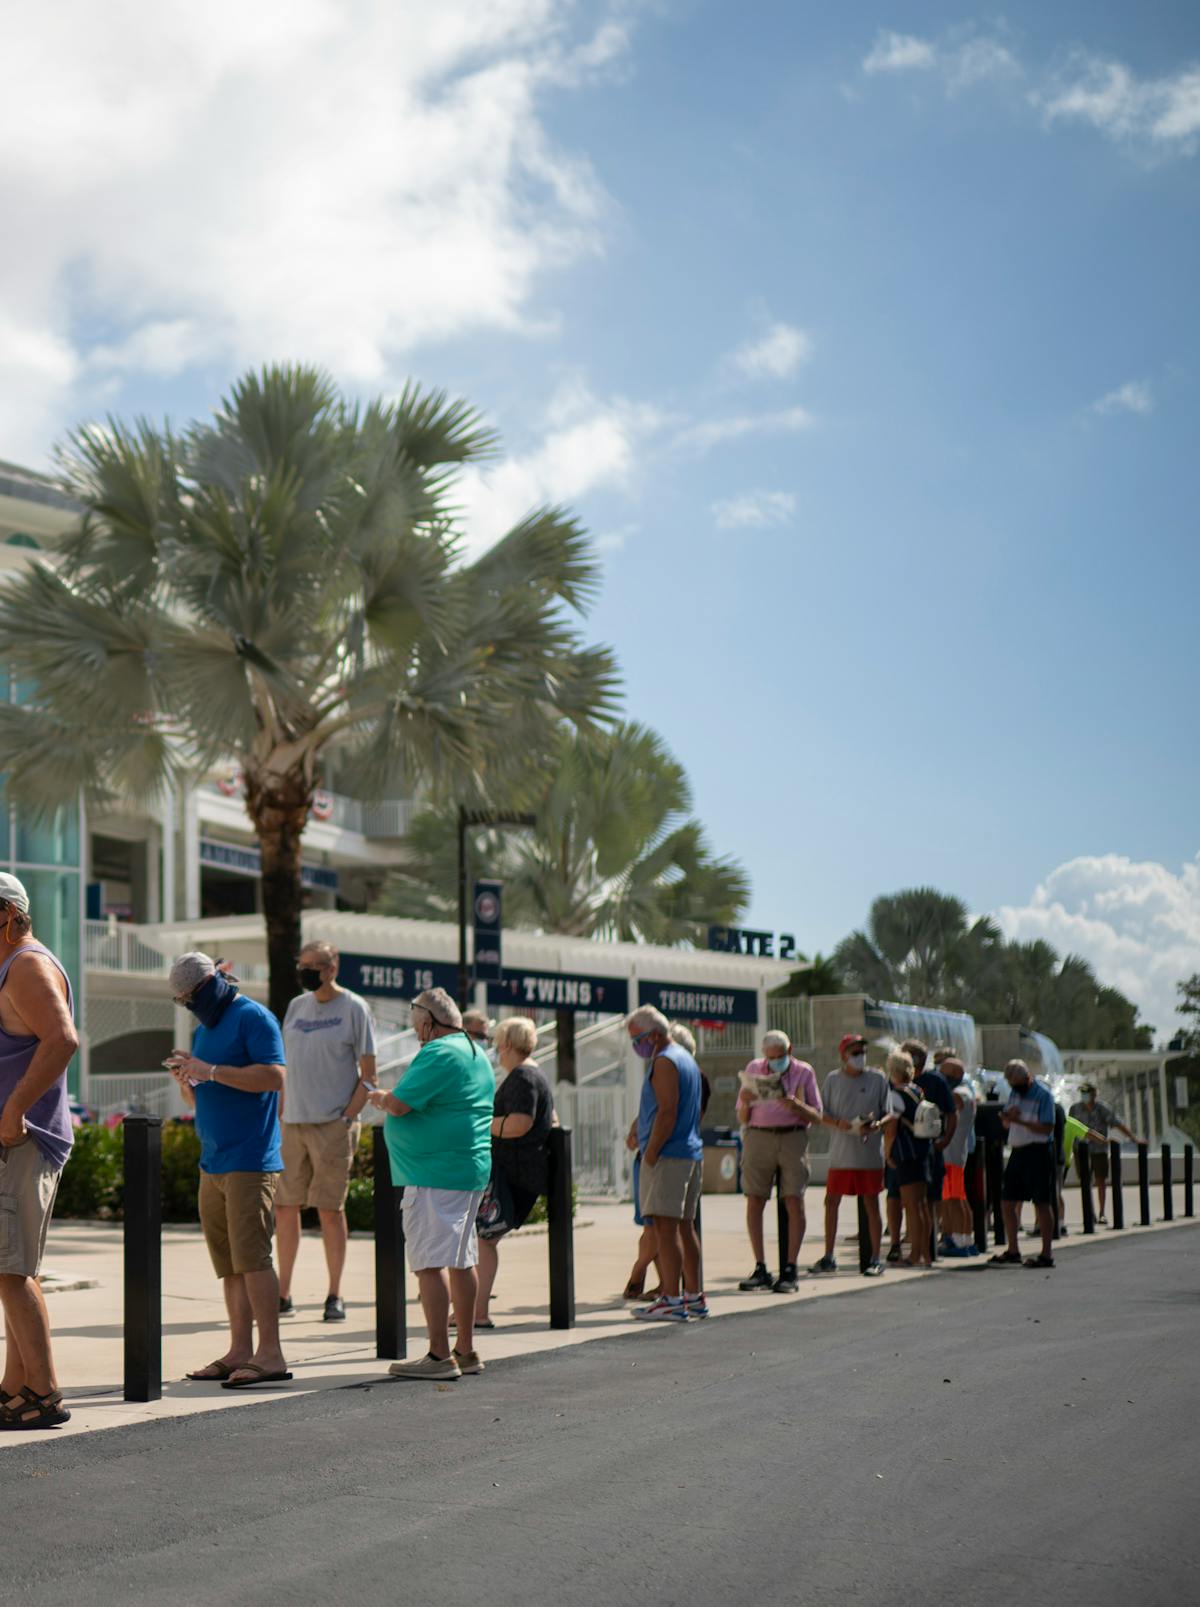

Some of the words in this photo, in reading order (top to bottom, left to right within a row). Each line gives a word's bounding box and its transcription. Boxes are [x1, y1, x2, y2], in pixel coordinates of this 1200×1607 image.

[708, 925, 774, 957] GATE
[779, 933, 796, 960] 2
[360, 964, 404, 988] THIS
[414, 969, 434, 990] IS
[523, 976, 592, 1006] TWINS
[659, 990, 735, 1015] TERRITORY
